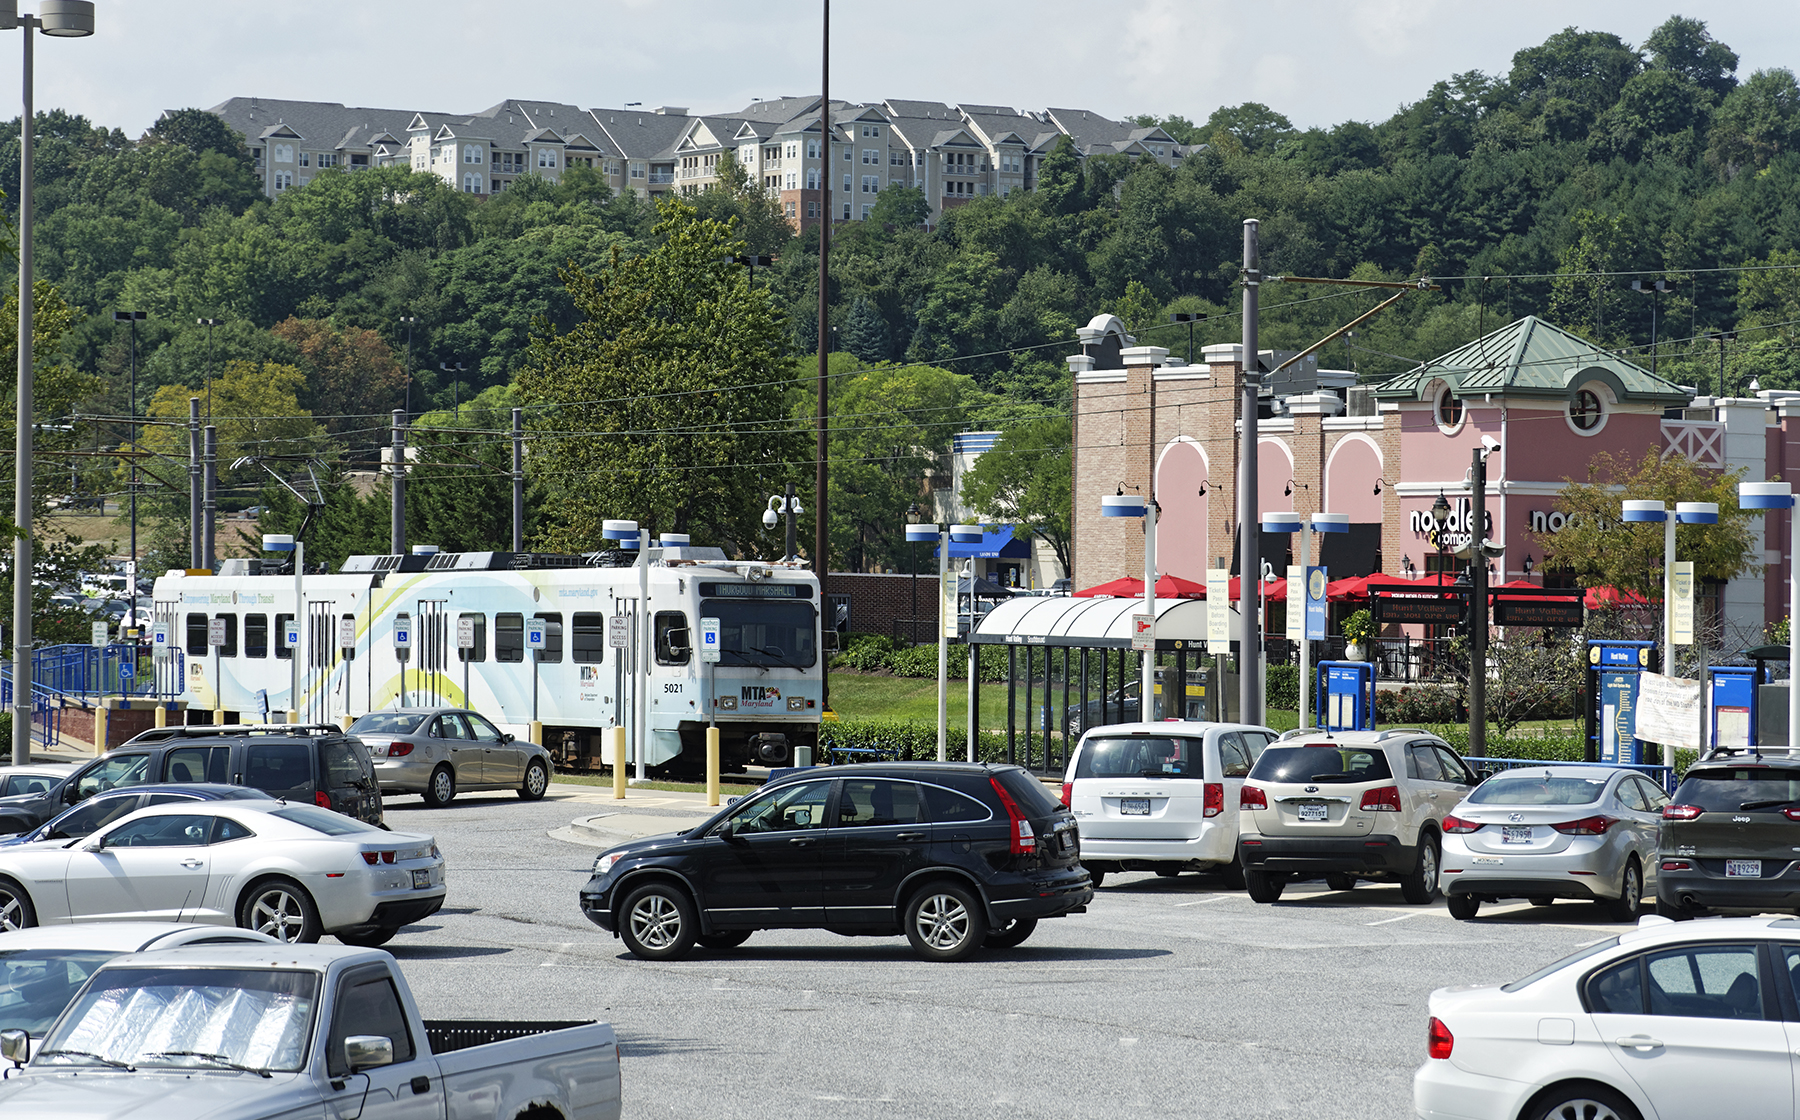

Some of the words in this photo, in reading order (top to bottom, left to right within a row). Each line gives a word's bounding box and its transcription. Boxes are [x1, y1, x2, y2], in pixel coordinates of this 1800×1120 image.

[558, 588, 598, 598] mta.maryland.gov
[720, 584, 752, 594] THURGOOD
[756, 586, 792, 596] MARSHALL
[184, 594, 209, 606] Empowering
[210, 594, 230, 606] Maryland
[238, 593, 257, 606] Through
[258, 594, 274, 604] Transit
[1540, 608, 1567, 616] Valley
[580, 666, 591, 680] MTA
[664, 684, 683, 693] 5021
[742, 686, 766, 700] MTA
